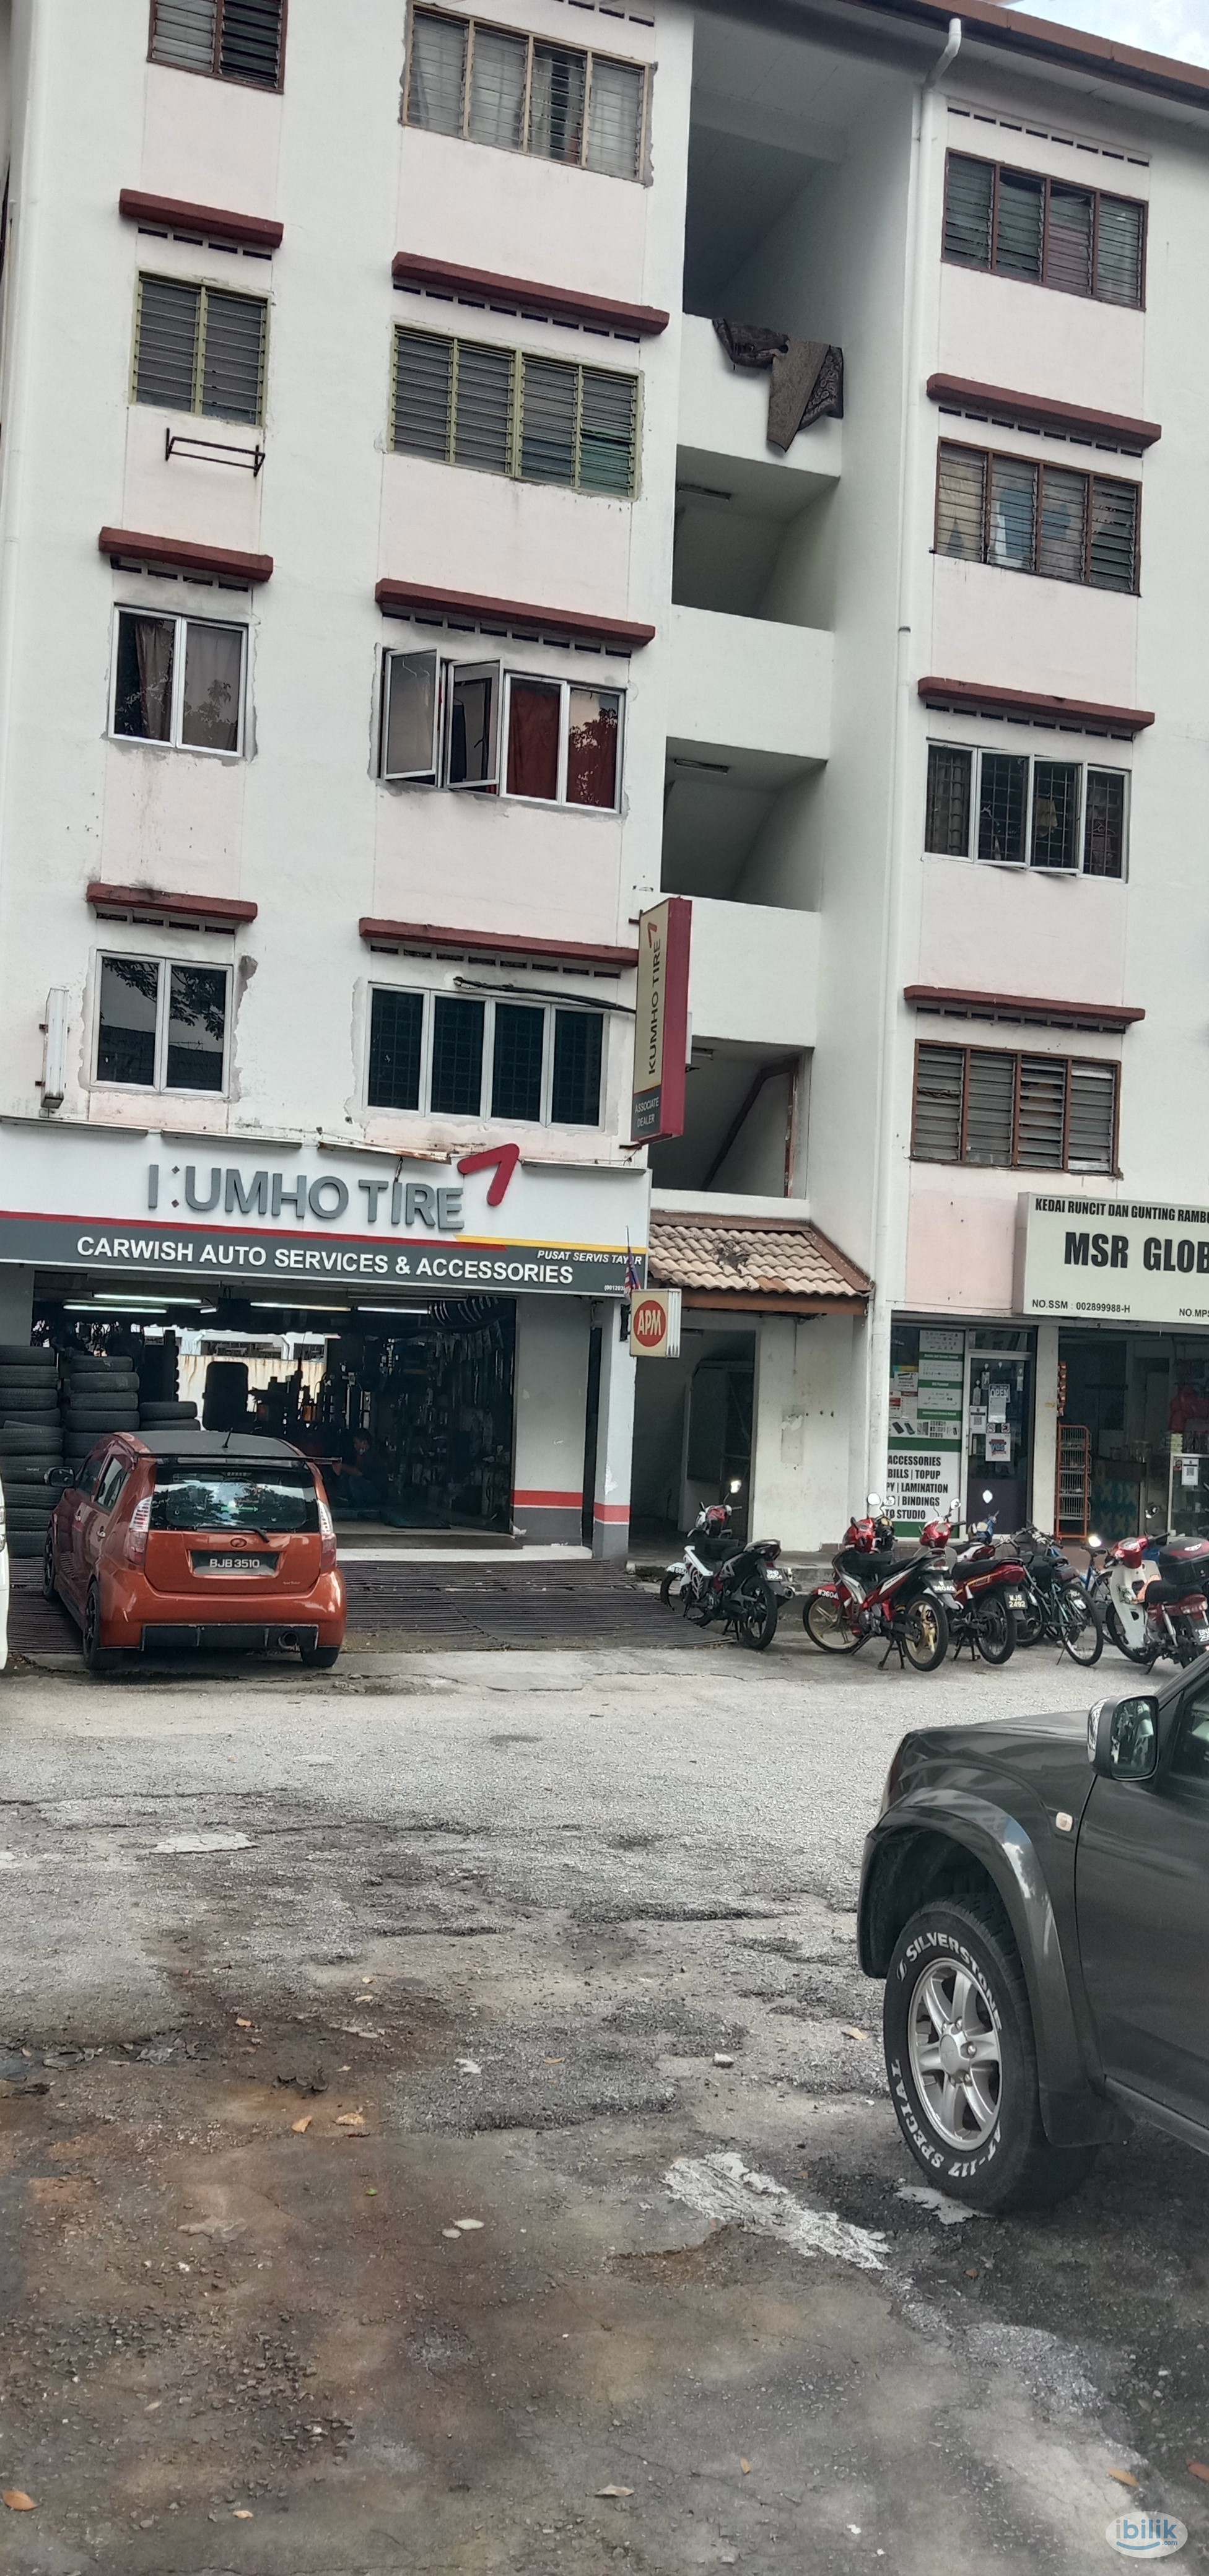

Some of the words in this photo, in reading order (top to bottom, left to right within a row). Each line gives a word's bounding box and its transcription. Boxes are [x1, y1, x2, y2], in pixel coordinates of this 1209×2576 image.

[652, 939, 661, 988] TIRE
[648, 991, 659, 1075] KUMHO
[634, 1097, 660, 1113] ASSOCIATE
[637, 1113, 655, 1128] DEALER
[358, 1179, 465, 1229] TIRE
[1035, 1198, 1065, 1213] KEDAI
[1067, 1200, 1106, 1216] RUNCIT
[1107, 1204, 1129, 1217] DAN
[1131, 1206, 1176, 1221] GUNTING
[77, 1236, 193, 1262] CARWISH
[199, 1245, 267, 1266] AUTO
[274, 1248, 388, 1274] SERVICES
[395, 1256, 411, 1275] &
[416, 1258, 574, 1284] ACCESSORIES
[536, 1250, 572, 1261] PUSAT
[572, 1252, 609, 1263] SERVIS
[611, 1255, 642, 1265] TAYR
[1064, 1232, 1129, 1269] MSR
[1143, 1237, 1209, 1274] GLOB
[1032, 1299, 1068, 1309] NO.SSM
[1076, 1302, 1130, 1313] 002899988-H
[637, 1310, 661, 1336] APM
[888, 1455, 941, 1466] ACCESSORIES
[888, 1469, 909, 1478] BILLS
[915, 1469, 940, 1479] TOPUP
[901, 1482, 948, 1493] LAMINATION
[902, 1496, 940, 1507] BINDINGS
[897, 1509, 925, 1520] STUDIO
[209, 1558, 233, 1568] BJB
[234, 1559, 260, 1568] 3510
[906, 1931, 1002, 2032] SILVERSTONE
[891, 2059, 945, 2168] SPECIAL
[948, 2120, 1002, 2177] AT-117
